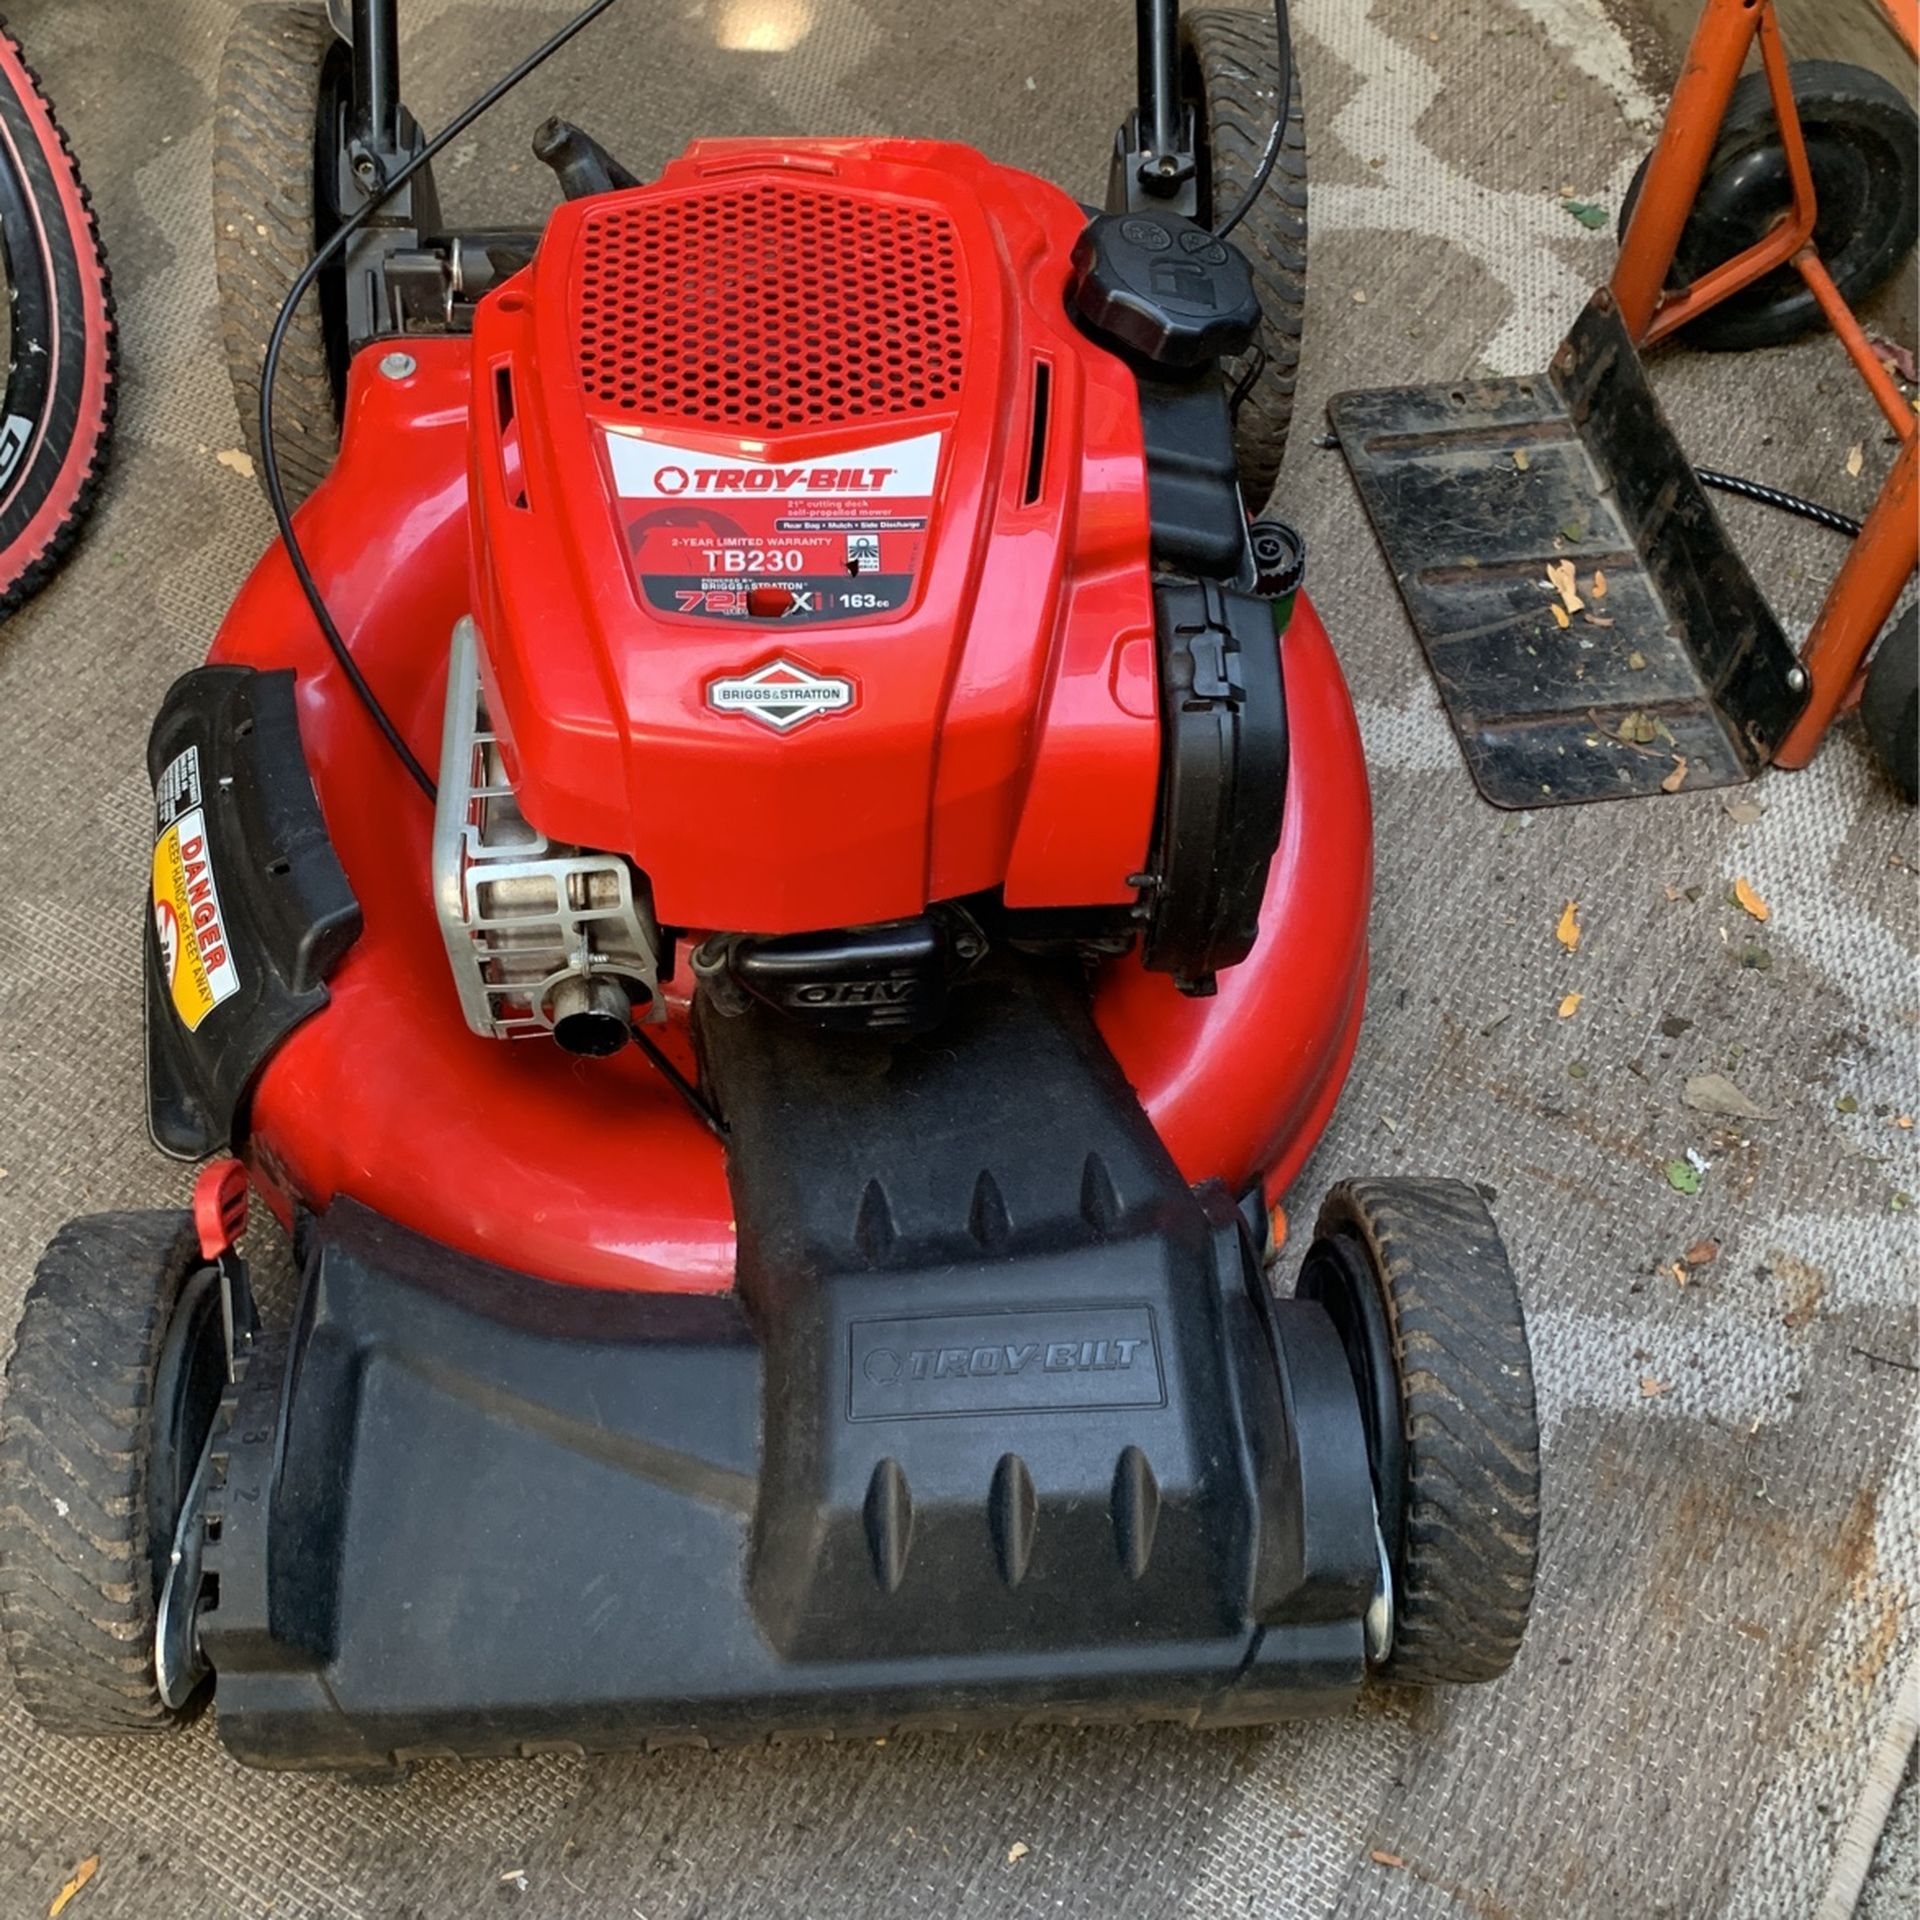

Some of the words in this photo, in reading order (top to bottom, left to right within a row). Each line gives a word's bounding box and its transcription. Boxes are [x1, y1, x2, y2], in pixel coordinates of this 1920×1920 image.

[693, 468, 892, 493] TROY-BILT
[787, 508, 857, 517] self-propelled
[806, 500, 842, 509] cutting
[844, 499, 869, 507] deck
[804, 522, 820, 530] Bag
[861, 521, 878, 529] Side
[880, 521, 920, 530] Discharge
[671, 538, 714, 547] 2-YEAR
[716, 537, 764, 546] LIMITED
[767, 537, 832, 546] WARRANTY
[702, 549, 803, 572] TB230
[722, 688, 841, 700] BRIGGS&STRATTON
[168, 835, 180, 865] KEEP
[171, 866, 188, 910] HANDS
[181, 834, 226, 975] DANGER
[179, 910, 191, 934] and
[184, 932, 199, 965] FEET
[193, 967, 212, 1004] AWAY
[908, 1338, 1142, 1381] TROY-BILT
[242, 1430, 269, 1446] 3
[234, 1486, 261, 1503] 2
